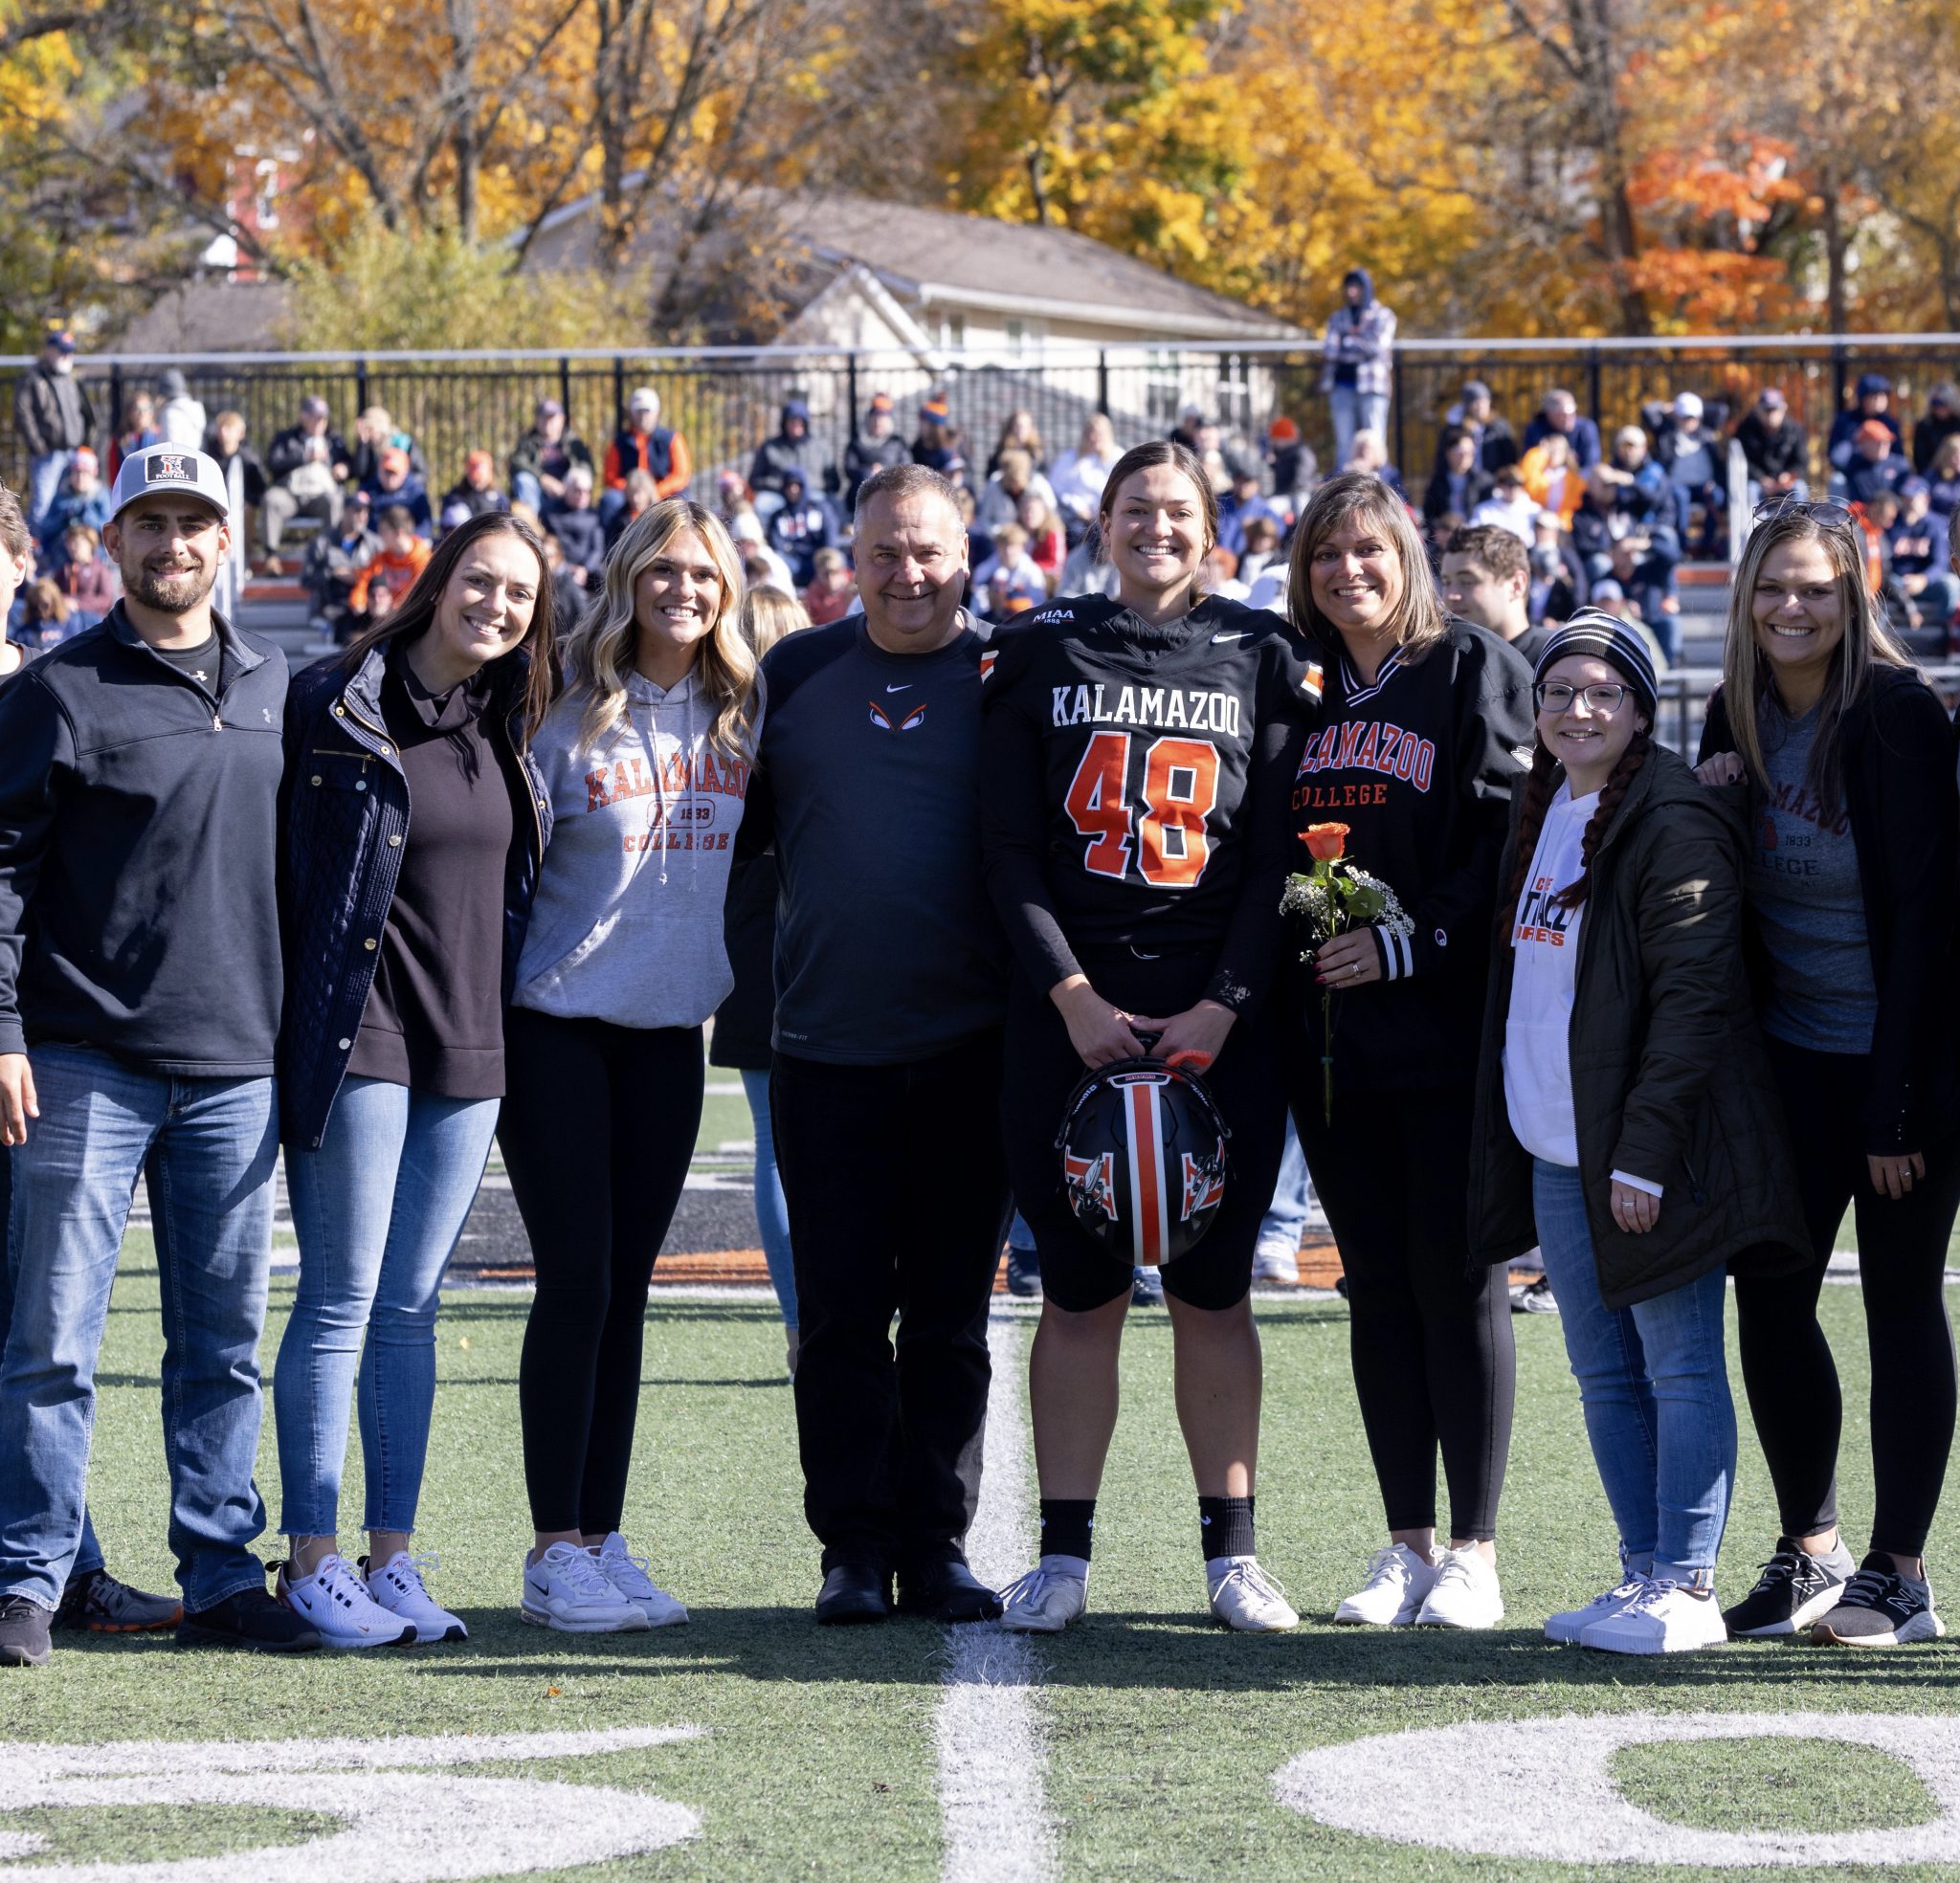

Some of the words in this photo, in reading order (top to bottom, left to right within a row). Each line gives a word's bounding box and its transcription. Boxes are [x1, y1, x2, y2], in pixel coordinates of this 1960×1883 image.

[1033, 609, 1075, 623] MIAA
[1052, 683, 1240, 738] KALAMAZOO
[584, 752, 751, 813] KALAMAZO
[1295, 720, 1436, 793] LAMAZOO
[1063, 730, 1221, 888] 48
[1292, 783, 1389, 810] COLLEGE
[1784, 834, 1812, 848] 1833
